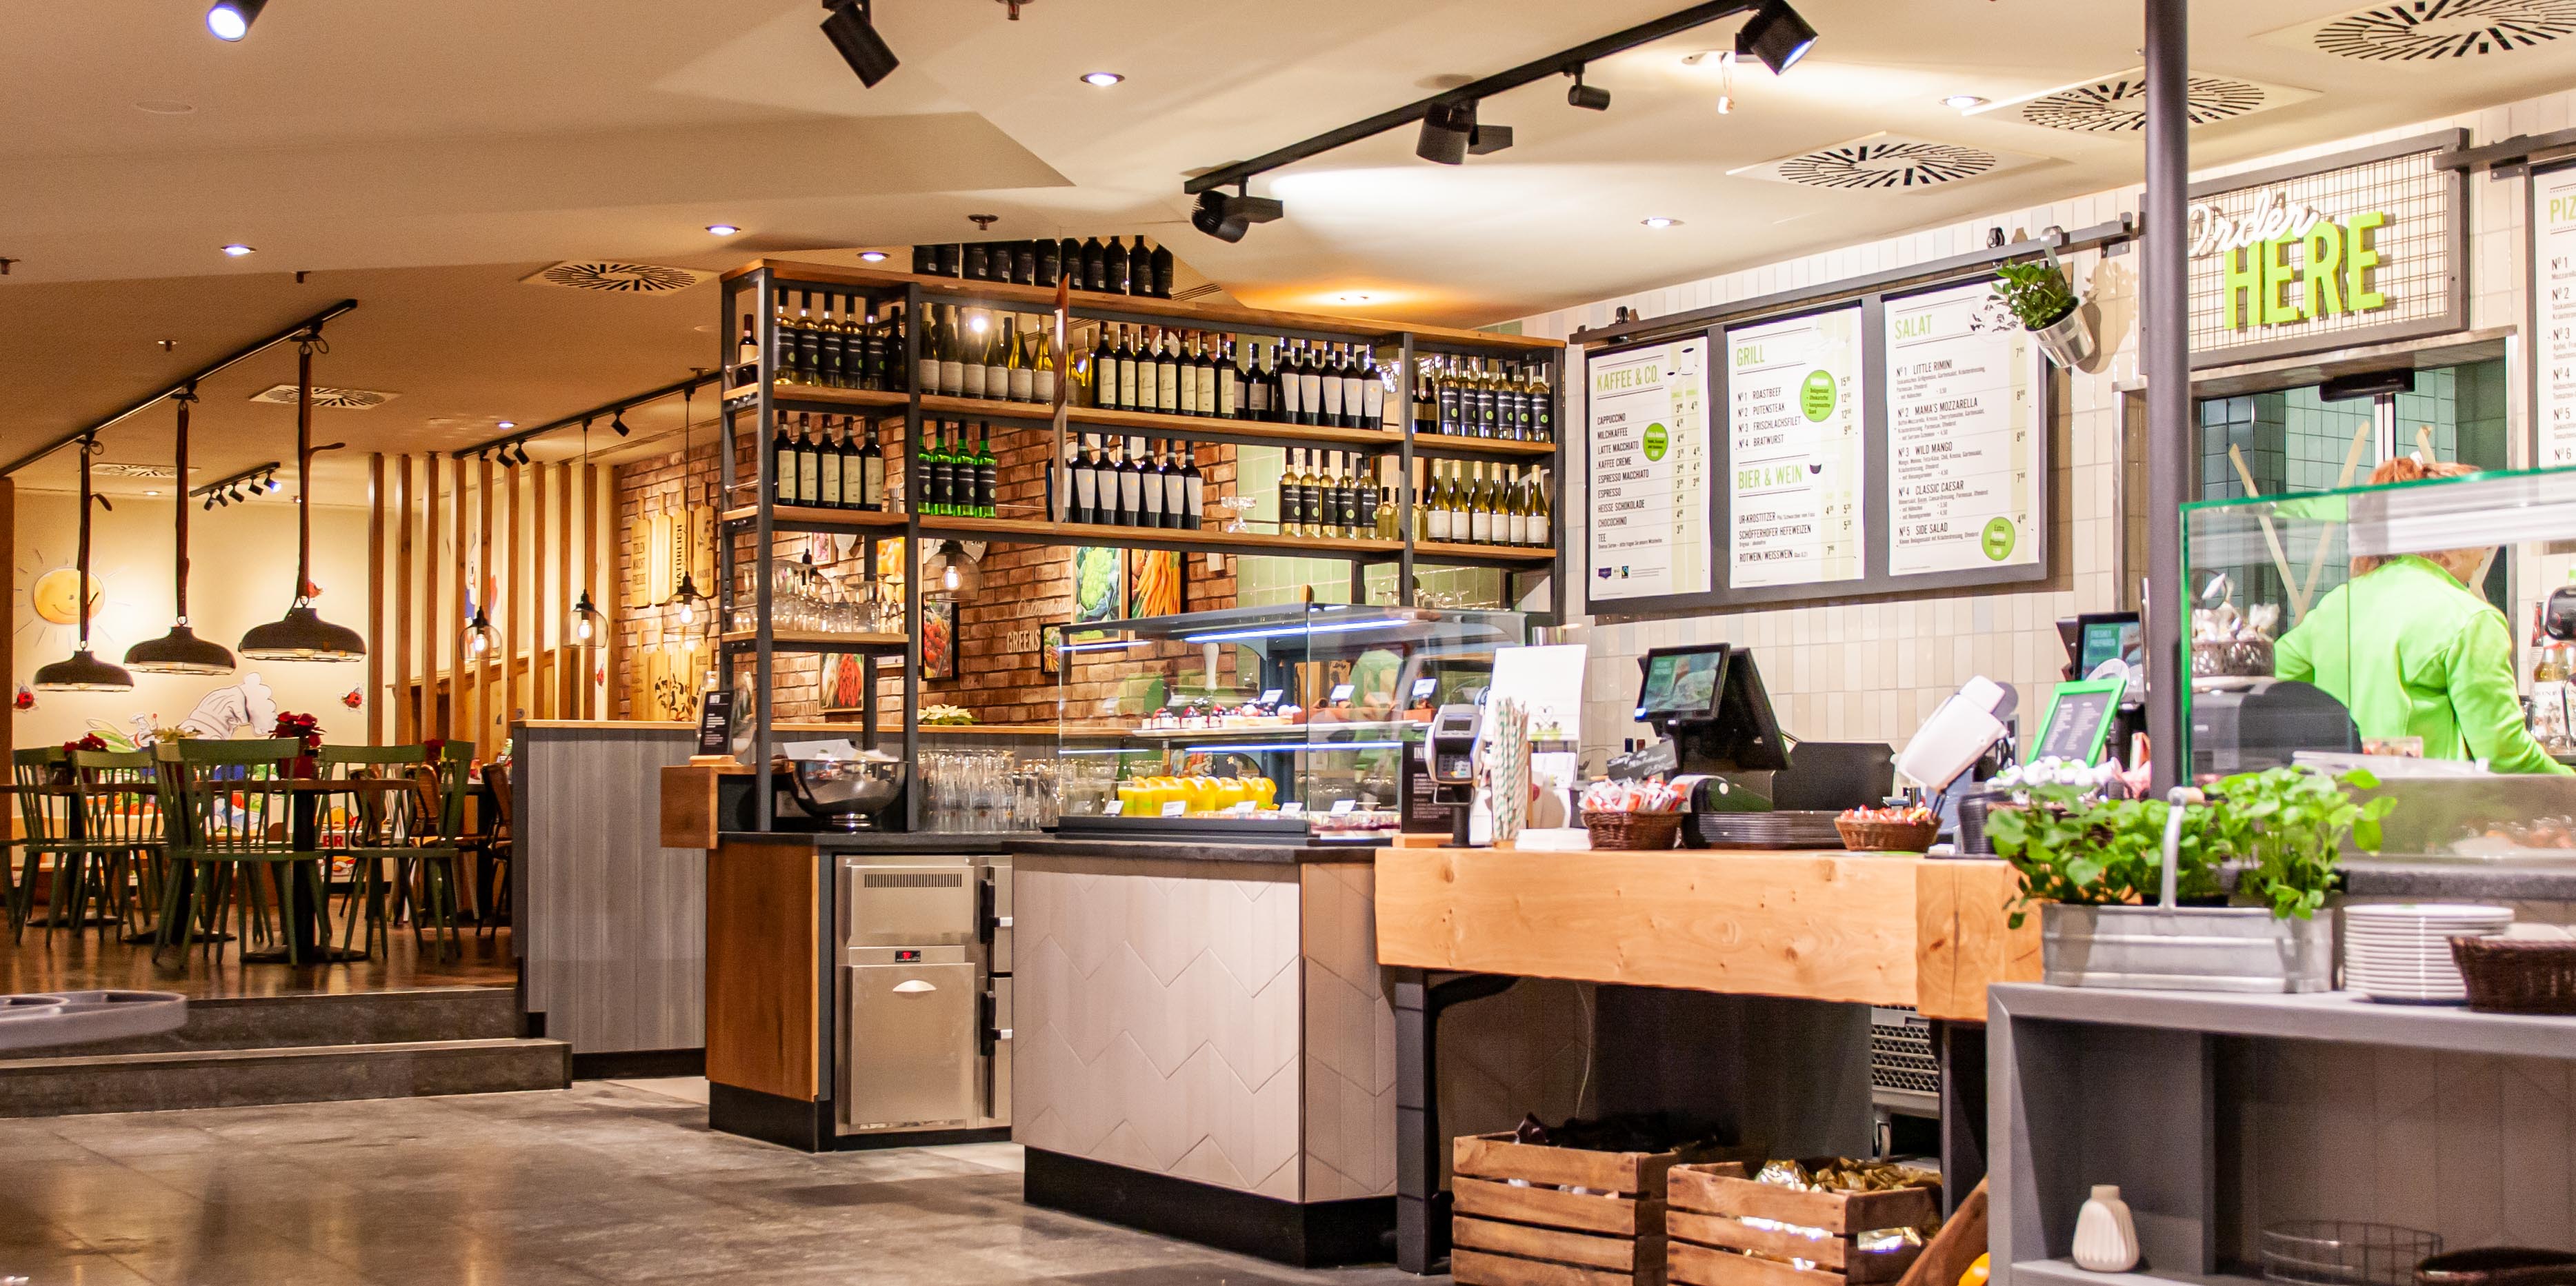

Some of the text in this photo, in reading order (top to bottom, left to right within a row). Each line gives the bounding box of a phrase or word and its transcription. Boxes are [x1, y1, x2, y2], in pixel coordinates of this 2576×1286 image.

[2189, 188, 2320, 257] Order
[2224, 211, 2385, 330] HERE
[1895, 314, 1932, 340] SALAT
[1737, 344, 1765, 366] GRILL
[1913, 363, 1931, 375] LITTLE
[1933, 359, 1953, 371] RIMINI
[1597, 365, 1660, 392] KAFFEE & CO.
[1753, 387, 1781, 400] ROASTBEEF
[1753, 403, 1786, 415] PUTENSTEAK
[1939, 397, 1978, 412] MOZZARELLA
[1597, 413, 1626, 425] CAPPUCCINO
[1753, 416, 1801, 431] FRISCHLACHSFILET
[1597, 427, 1628, 439] MILCHKAFFEE
[1598, 444, 1611, 454] LATTE
[1613, 441, 1639, 452] MACCHIATO
[1753, 434, 1784, 447] BRATWURST
[1915, 444, 1929, 455] WILD
[1931, 441, 1953, 453] MANGO
[1598, 459, 1615, 469] KAFFEE
[1598, 469, 1649, 484] ESPRESSO MACCHIATO
[1738, 465, 1802, 490] BIER & WEIN
[1598, 488, 1621, 499] ESPRESSO
[1915, 483, 1939, 495] CLASSIC
[1941, 480, 1964, 492] CAESAR
[1598, 499, 1645, 513] HEISSE SCHOKOLADE
[1598, 516, 1627, 528] CHOCOCHINO
[1739, 512, 1776, 524] UR-KROSTITZER
[1779, 524, 1811, 536] HEFEWEIZEN
[1915, 525, 1928, 535] SIDE
[1929, 522, 1948, 533] SALAD
[1598, 534, 1606, 542] TEE
[1007, 629, 1041, 653] GREENS
